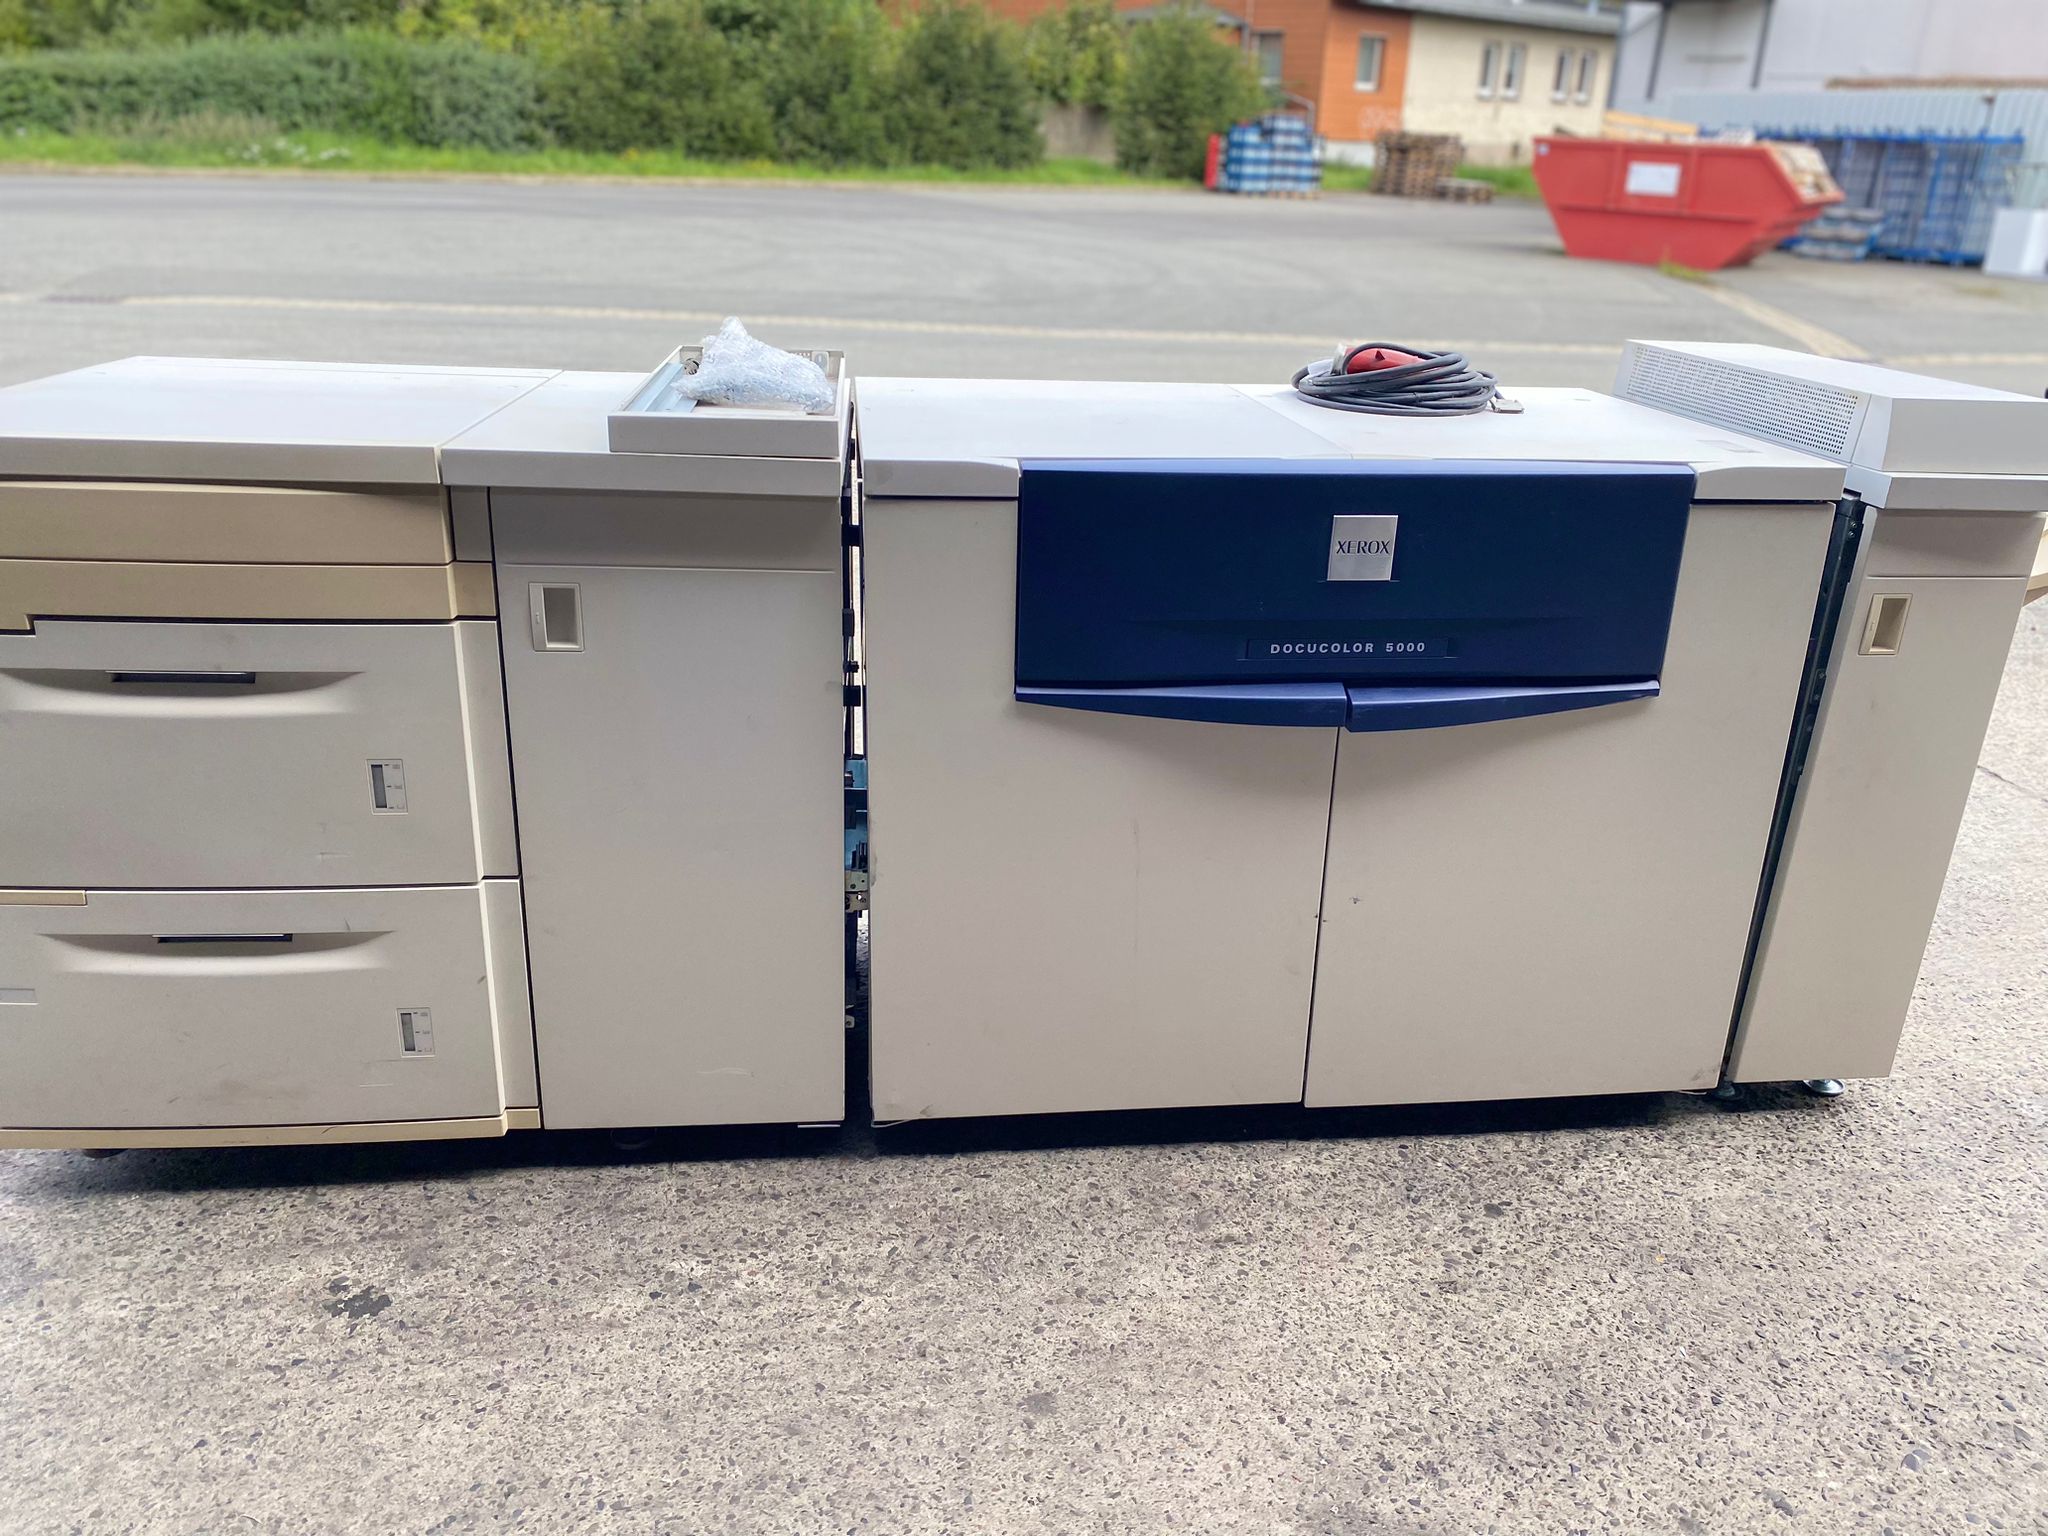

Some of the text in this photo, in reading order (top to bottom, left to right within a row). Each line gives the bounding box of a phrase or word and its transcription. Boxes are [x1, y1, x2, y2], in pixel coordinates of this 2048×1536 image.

[1335, 540, 1391, 554] XEROX
[1270, 642, 1426, 654] DOCUCOLOR 5000
